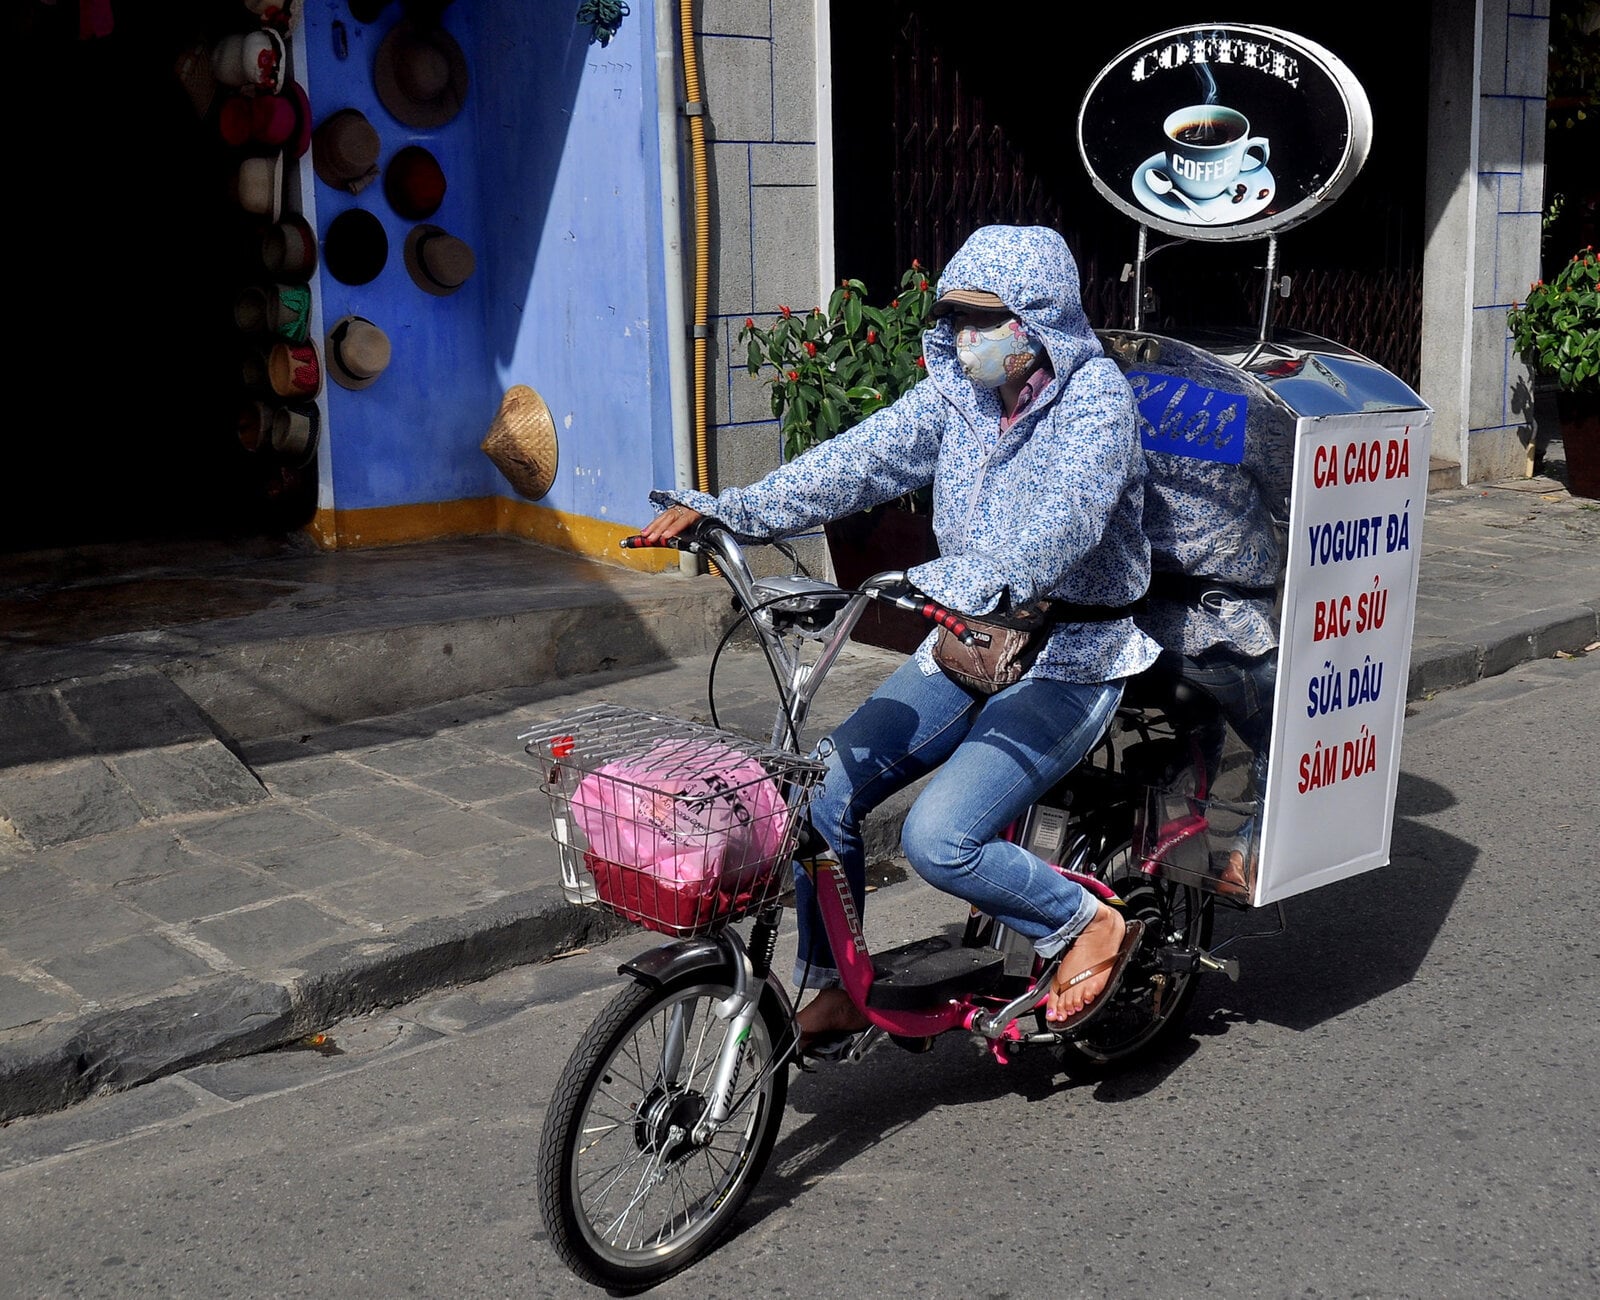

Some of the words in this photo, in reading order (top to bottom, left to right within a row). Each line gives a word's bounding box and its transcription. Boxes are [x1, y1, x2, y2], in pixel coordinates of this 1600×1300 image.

[1131, 38, 1299, 89] COFFEE
[1172, 153, 1234, 182] COFFEE
[1313, 445, 1338, 489] CA
[1344, 440, 1381, 485] CAO
[1385, 426, 1410, 480] ĐÁ
[1308, 516, 1382, 566] YOGURT
[1386, 499, 1410, 553] ĐÁ
[1313, 595, 1351, 642] BAC
[1307, 660, 1342, 718] SỮA
[1347, 655, 1383, 707] DÂU
[1298, 740, 1338, 794] SÂM
[1341, 724, 1376, 780] DỨA
